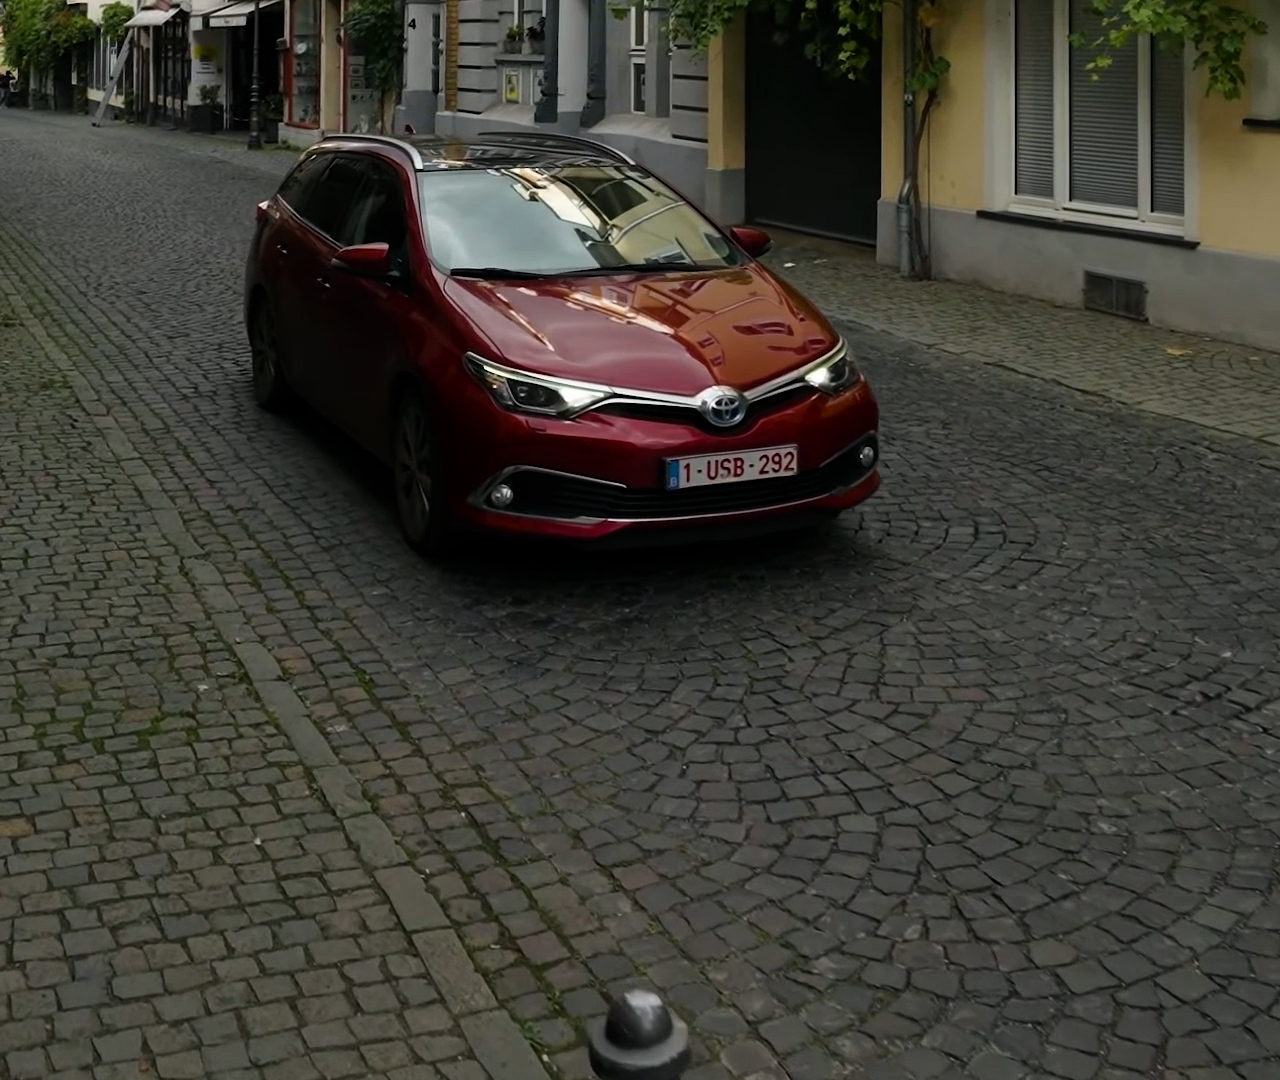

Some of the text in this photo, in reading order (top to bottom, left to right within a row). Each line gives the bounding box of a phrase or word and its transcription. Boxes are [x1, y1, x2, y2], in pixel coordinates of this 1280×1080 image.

[407, 17, 417, 30] 4
[683, 451, 795, 484] 1-USB-292
[670, 477, 677, 488] B
